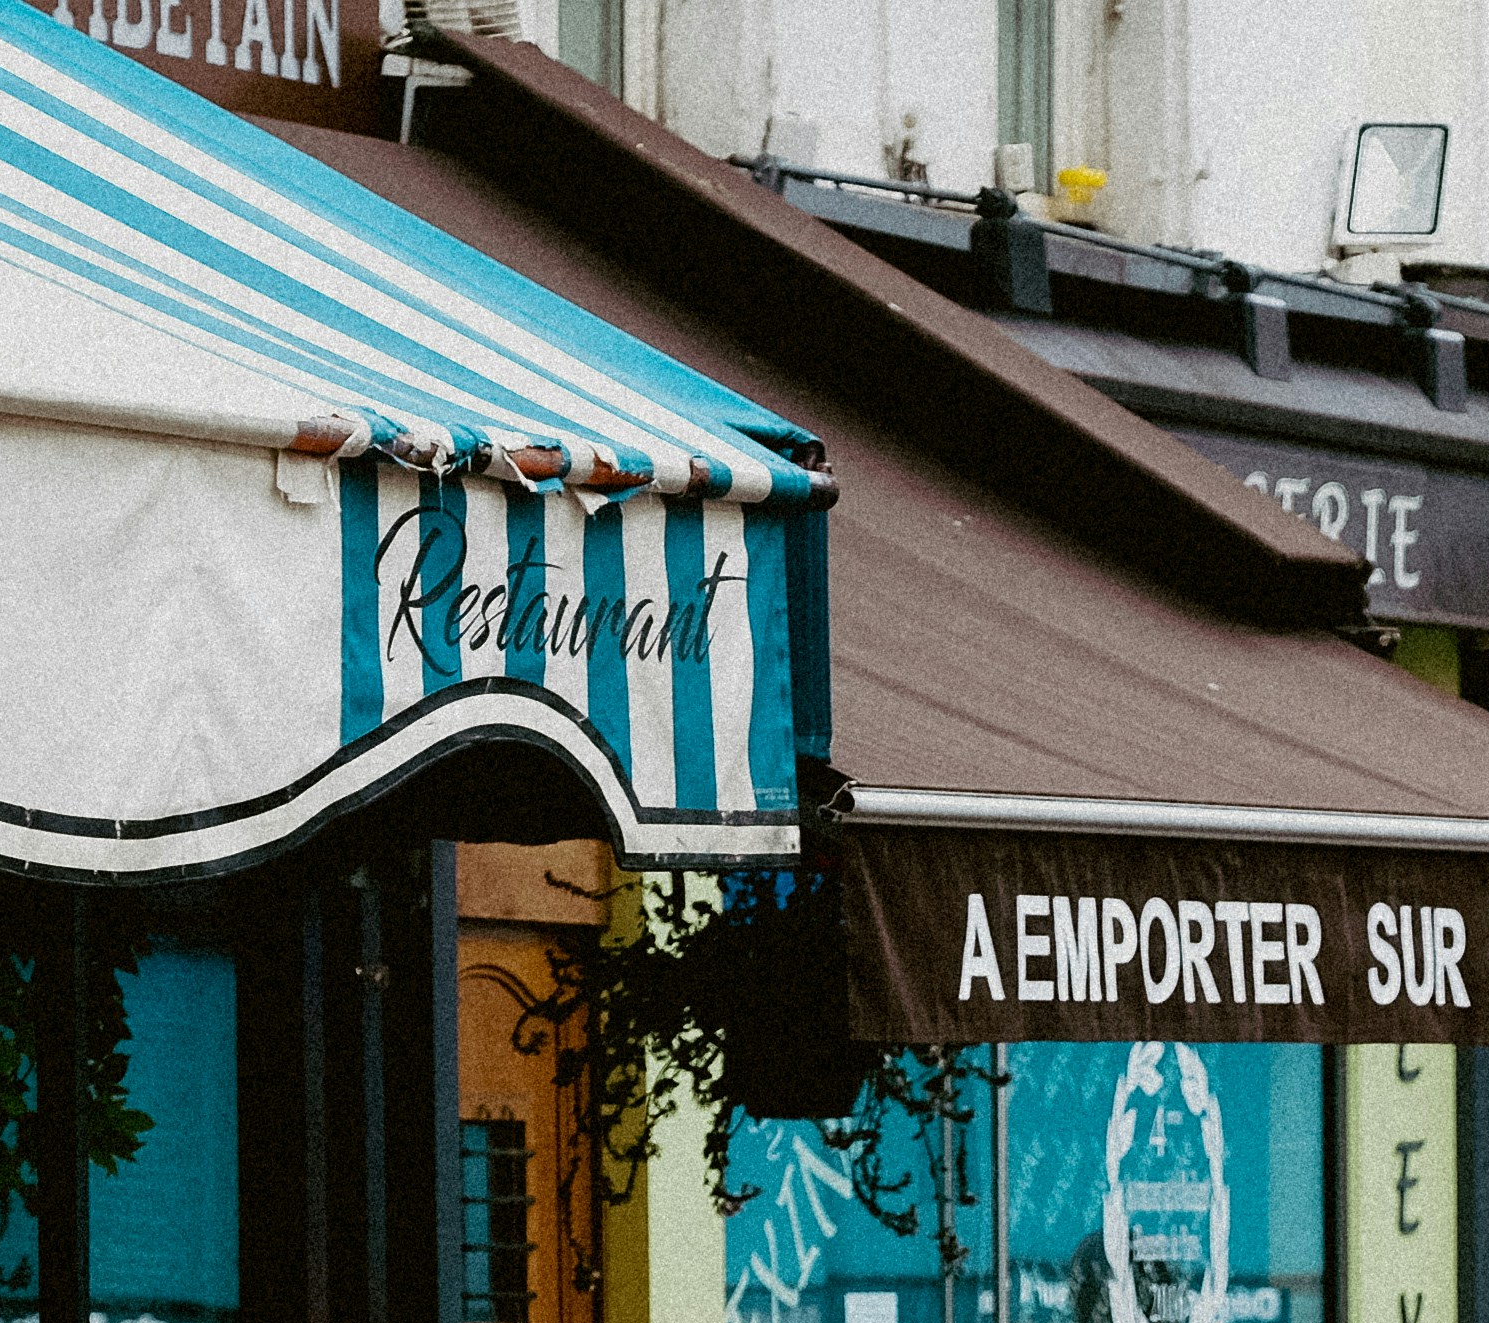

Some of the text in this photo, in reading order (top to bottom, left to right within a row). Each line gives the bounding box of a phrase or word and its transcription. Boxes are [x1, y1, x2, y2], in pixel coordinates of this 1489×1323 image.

[1244, 470, 1425, 589] RIE
[374, 506, 721, 676] Restaurant
[959, 894, 1006, 1001] A
[1016, 894, 1325, 1005] EMPORTER
[1367, 901, 1471, 1008] SUR
